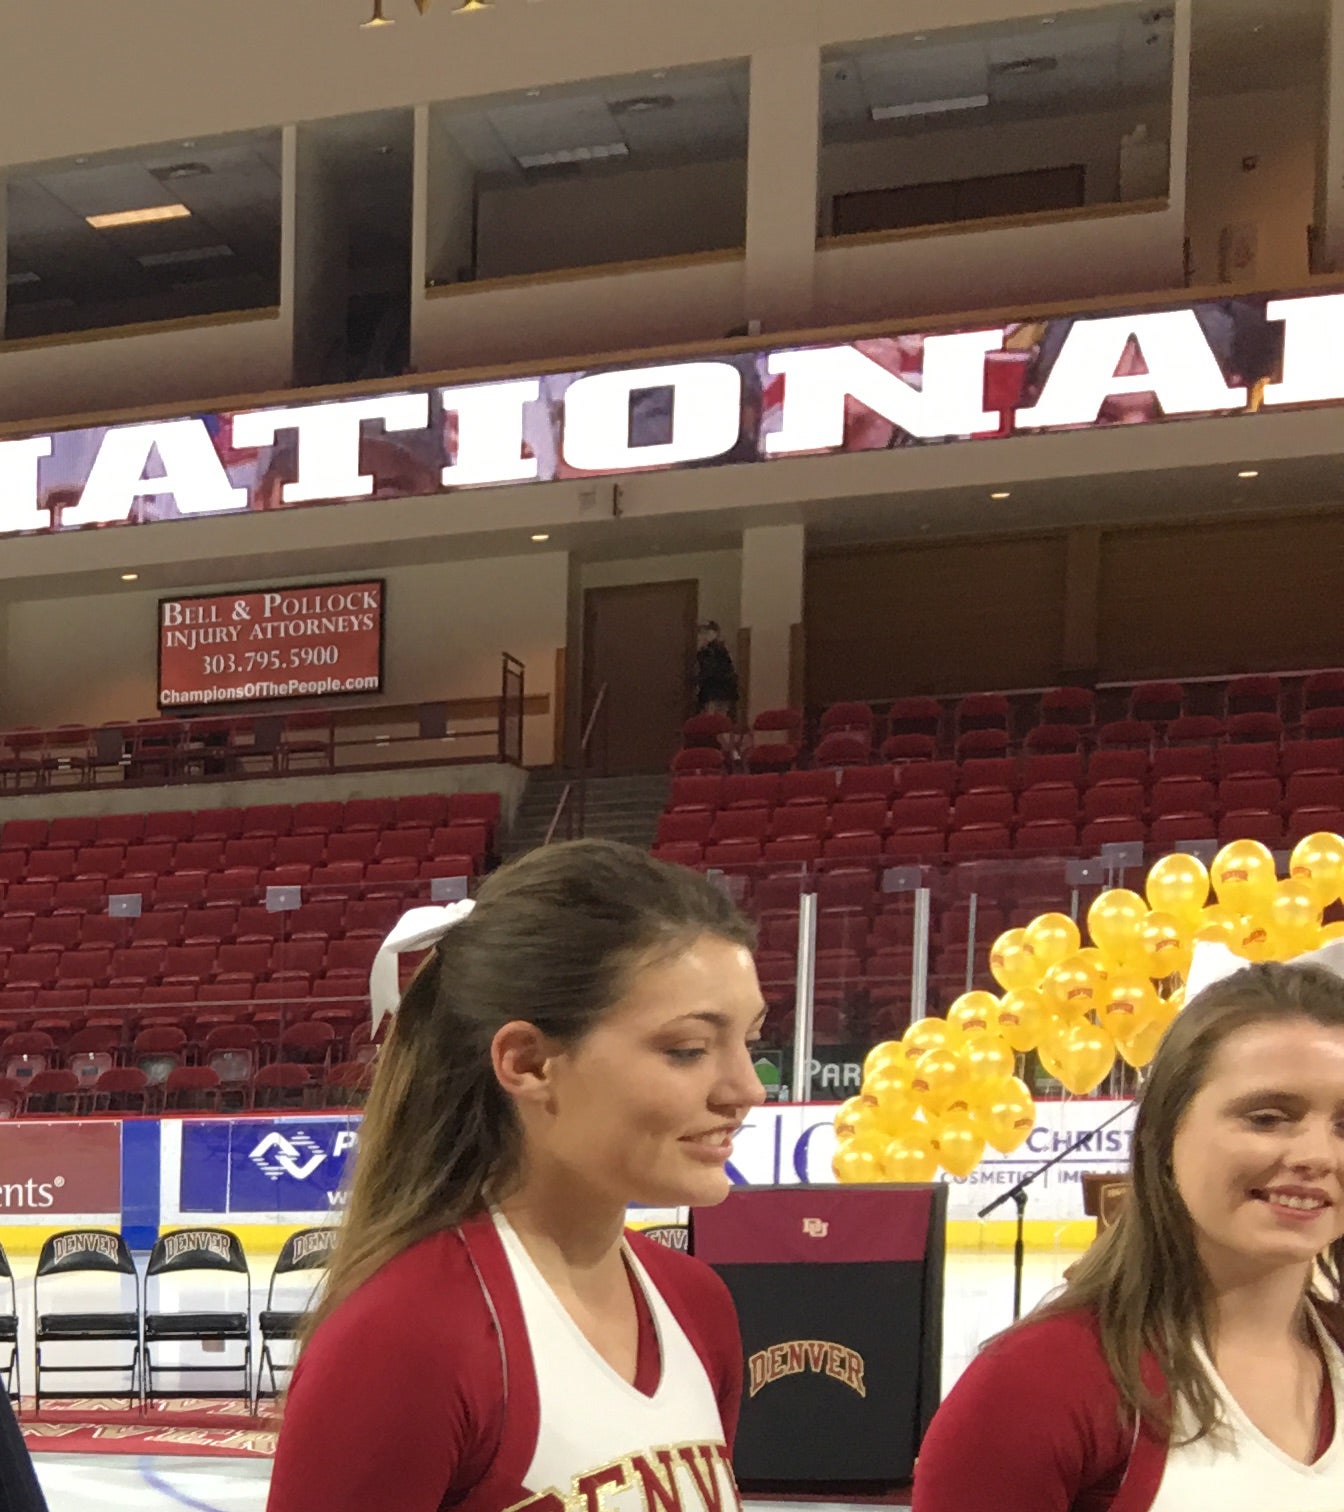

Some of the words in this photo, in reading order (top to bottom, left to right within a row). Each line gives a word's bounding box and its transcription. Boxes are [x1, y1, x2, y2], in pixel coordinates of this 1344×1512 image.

[231, 600, 252, 621] &
[263, 591, 379, 618] POLLOCK
[166, 625, 242, 650] INJURY
[248, 613, 375, 641] ATTORNEYS
[202, 645, 339, 675] 303.795.5900
[160, 676, 380, 704] ChampionsOfThePeople.com
[53, 1232, 120, 1265] DENVER
[164, 1231, 231, 1264] DENVER
[748, 1340, 866, 1398] DENVER
